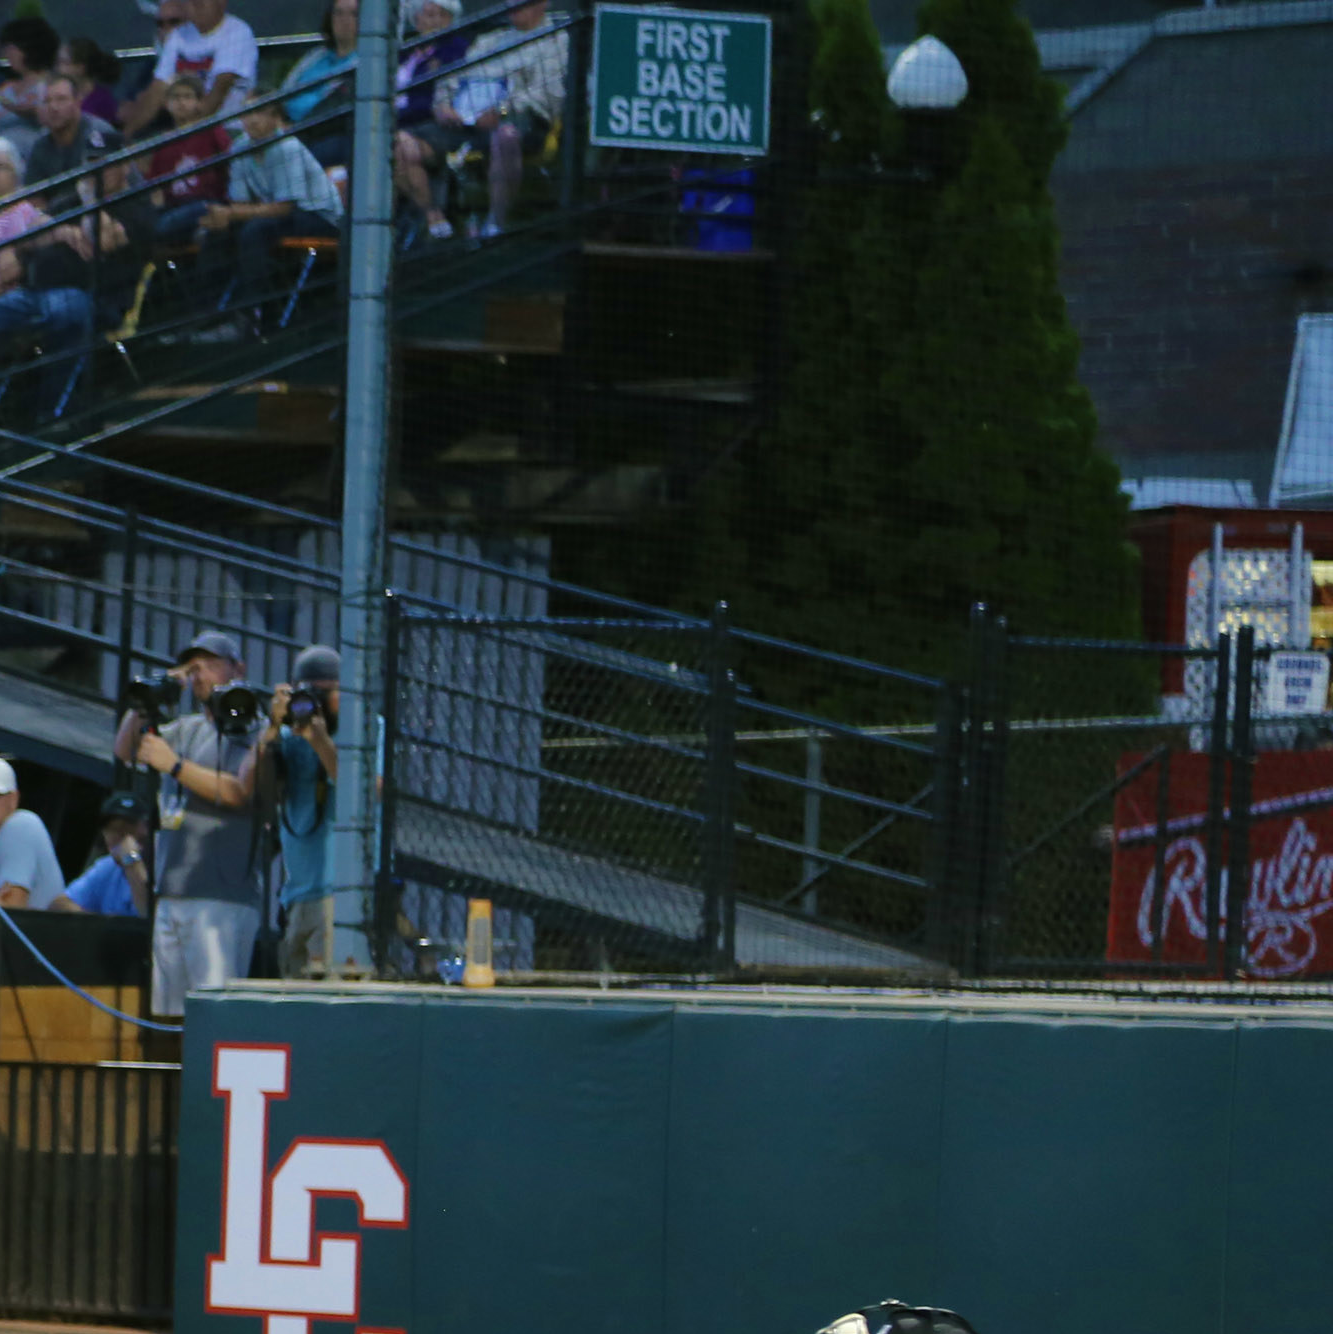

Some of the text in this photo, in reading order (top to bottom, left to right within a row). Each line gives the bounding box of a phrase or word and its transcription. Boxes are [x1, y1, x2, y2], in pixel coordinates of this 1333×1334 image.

[637, 19, 731, 62] FIRST
[637, 59, 727, 101] BASE
[608, 95, 752, 142] SECTION
